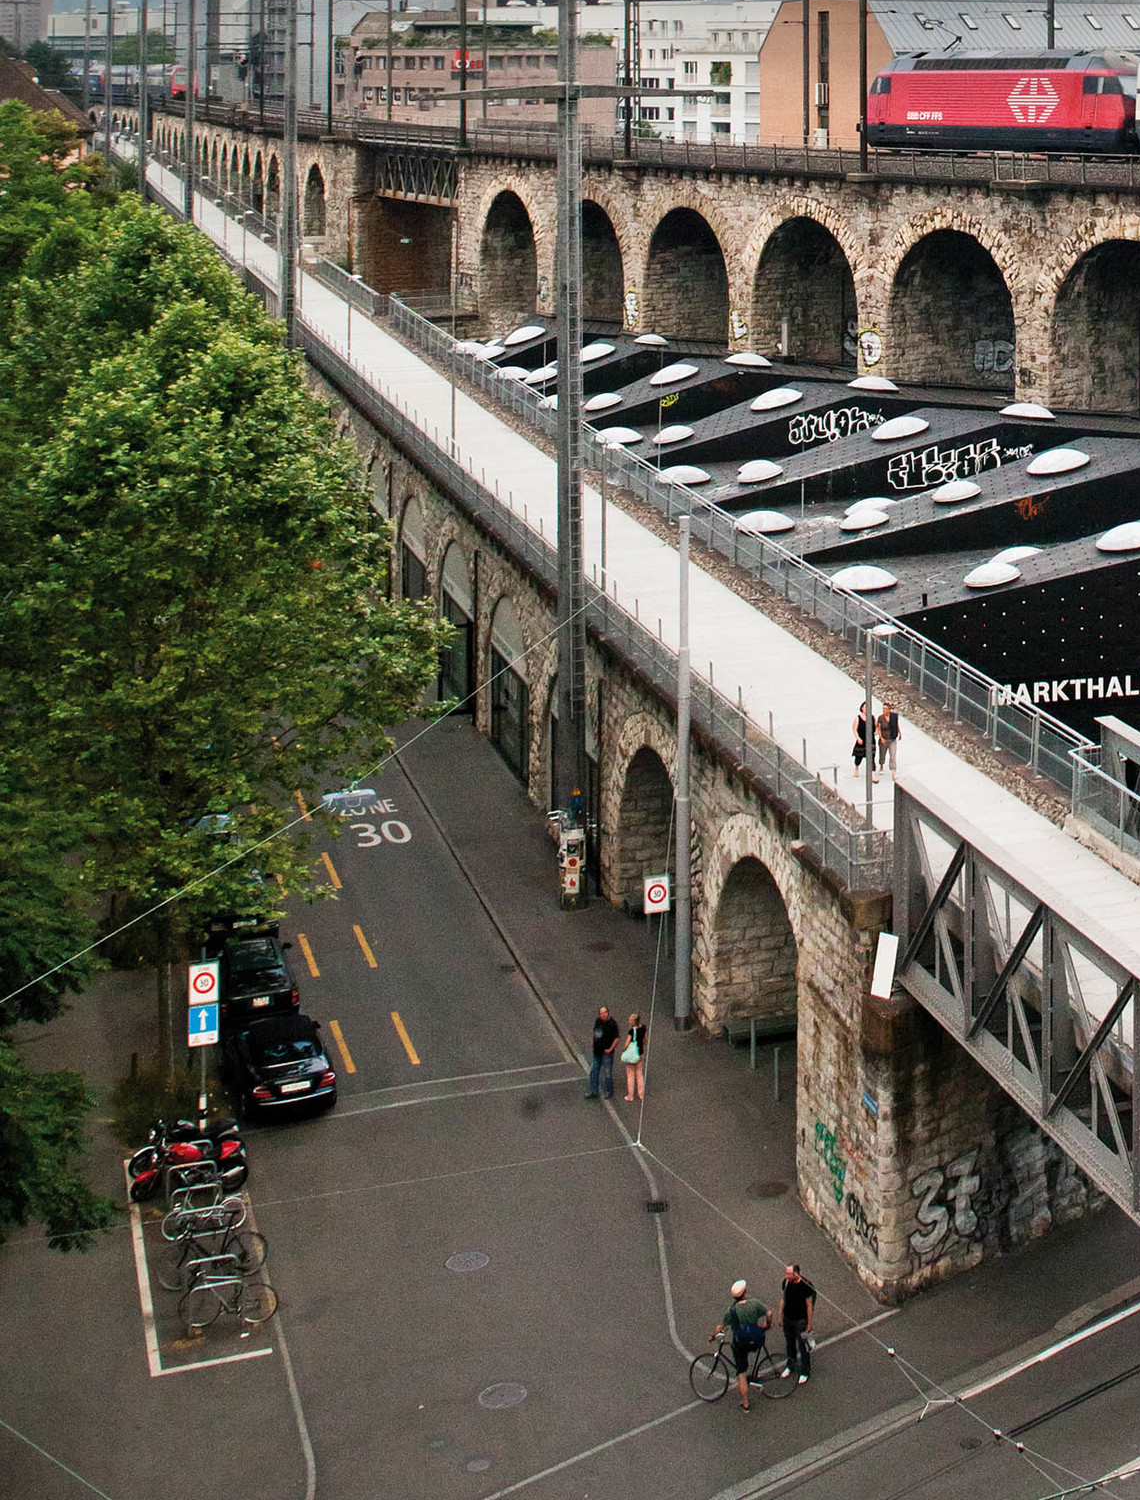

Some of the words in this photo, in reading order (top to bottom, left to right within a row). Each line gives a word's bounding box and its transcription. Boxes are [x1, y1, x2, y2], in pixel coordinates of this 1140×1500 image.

[931, 111, 943, 120] FFS
[341, 798, 399, 817] NE
[349, 820, 412, 848] 30
